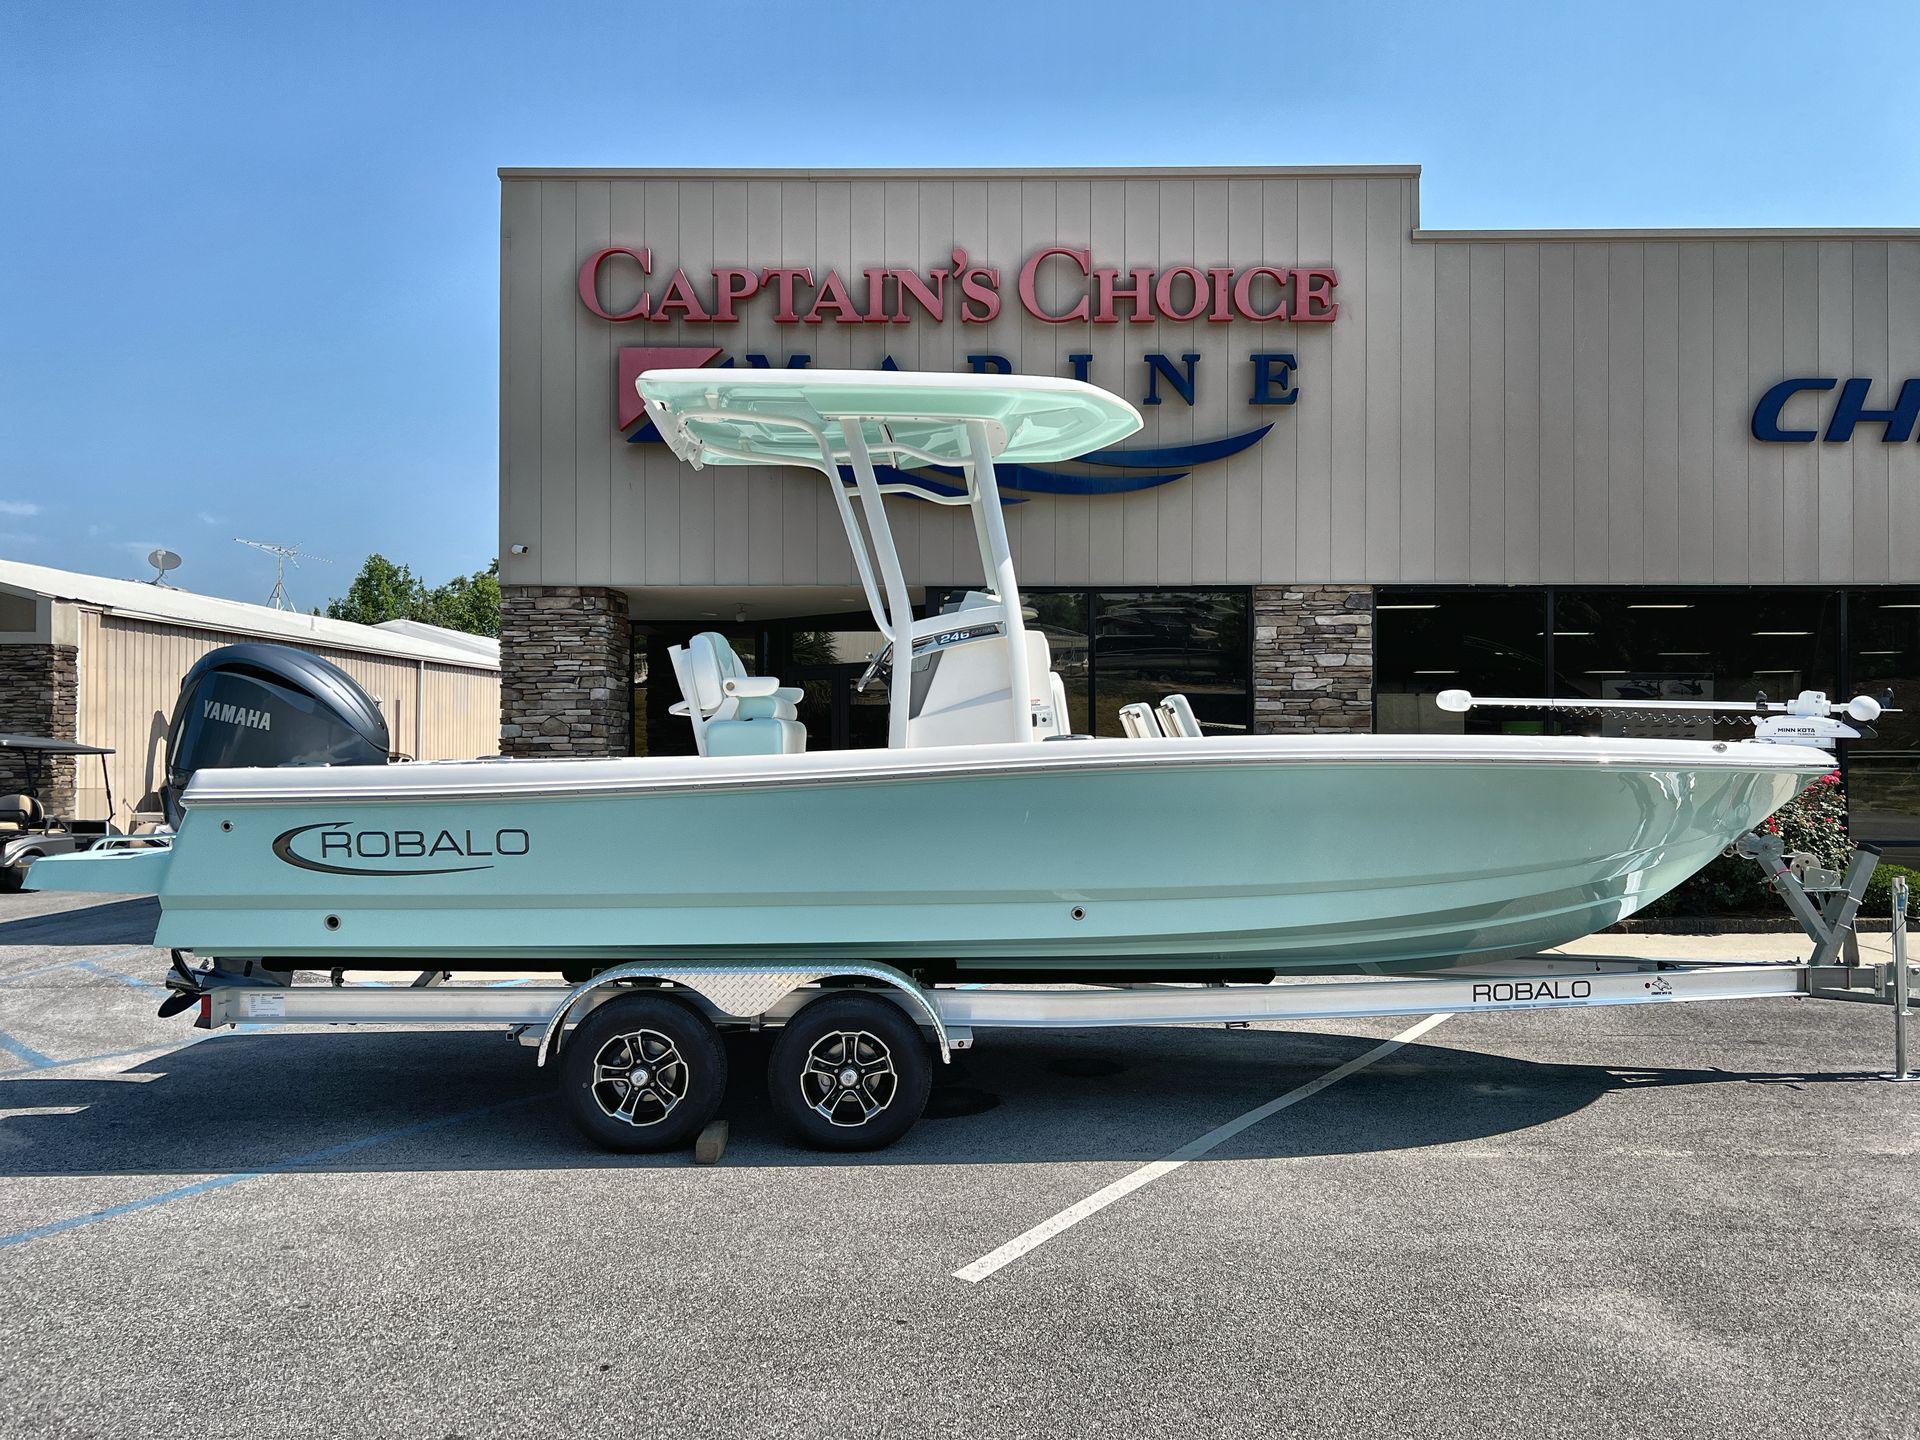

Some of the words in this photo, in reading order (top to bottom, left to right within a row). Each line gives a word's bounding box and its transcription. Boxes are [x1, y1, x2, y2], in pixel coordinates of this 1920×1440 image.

[578, 247, 1001, 324] CAPTAIN'S
[1018, 247, 1340, 324] CHOICE
[1751, 378, 1920, 442] CH
[940, 631, 970, 644] 246
[203, 700, 272, 731] YAMAHA
[320, 828, 530, 859] ROBALO
[1472, 980, 1592, 1002] ROBALO
